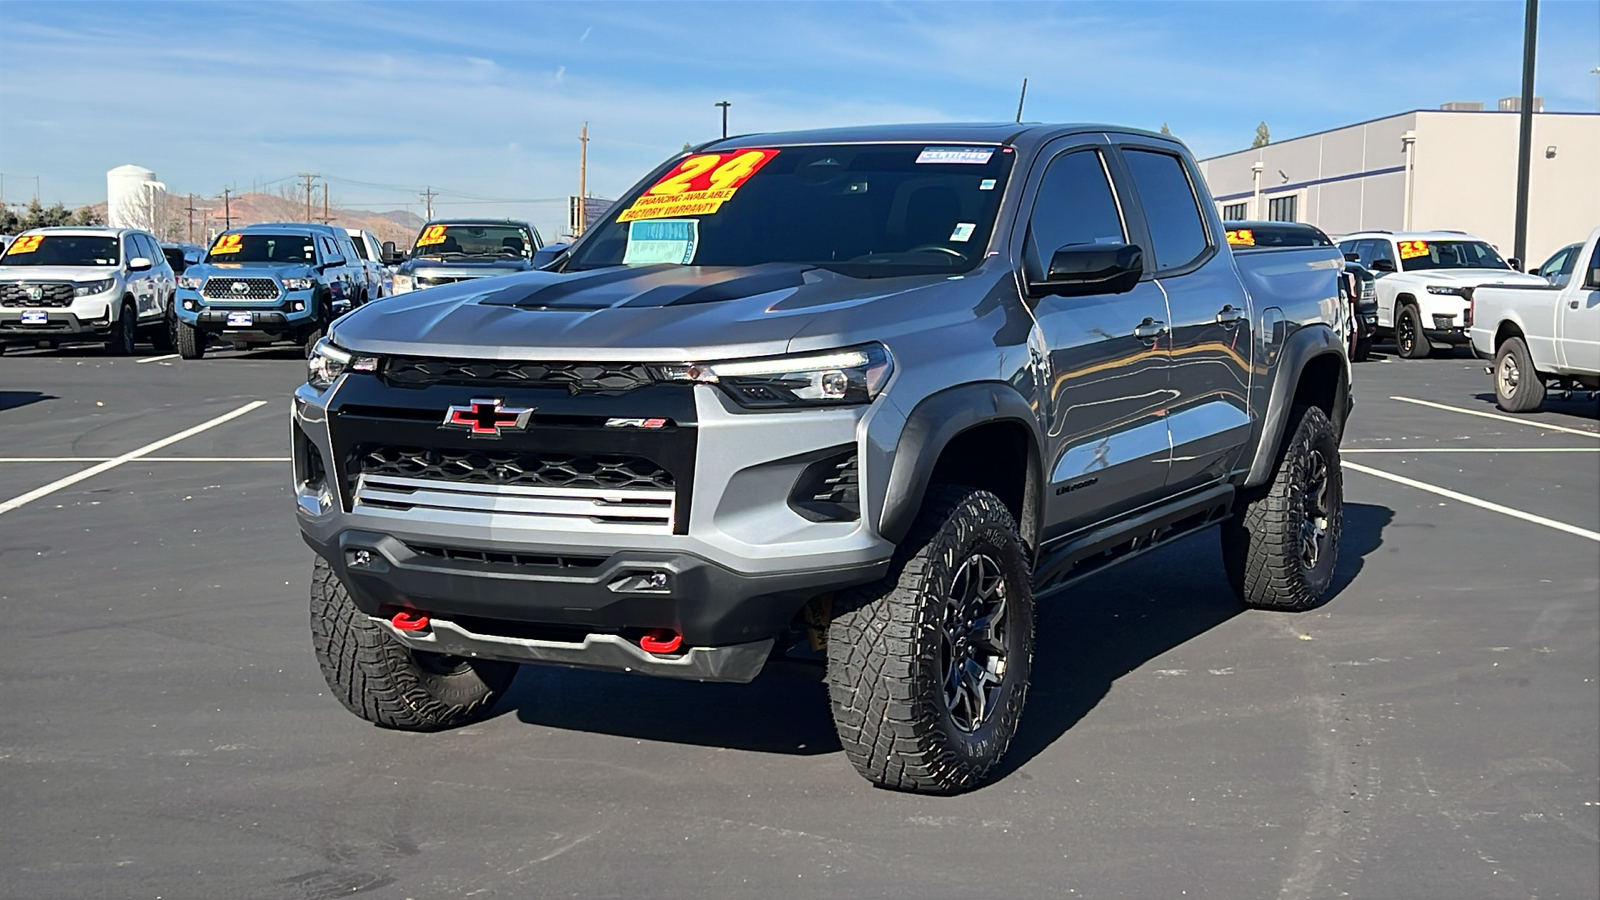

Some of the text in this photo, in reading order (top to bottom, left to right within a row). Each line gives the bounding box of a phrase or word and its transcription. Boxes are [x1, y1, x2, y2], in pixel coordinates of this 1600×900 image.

[921, 151, 990, 160] CERTIFIED
[649, 150, 766, 195] 24
[635, 190, 733, 206] FINANCING AVAILABLE
[623, 206, 665, 220] FACTORY
[663, 202, 717, 216] WARRANTY
[13, 235, 44, 247] 22
[603, 417, 667, 429] ZR2
